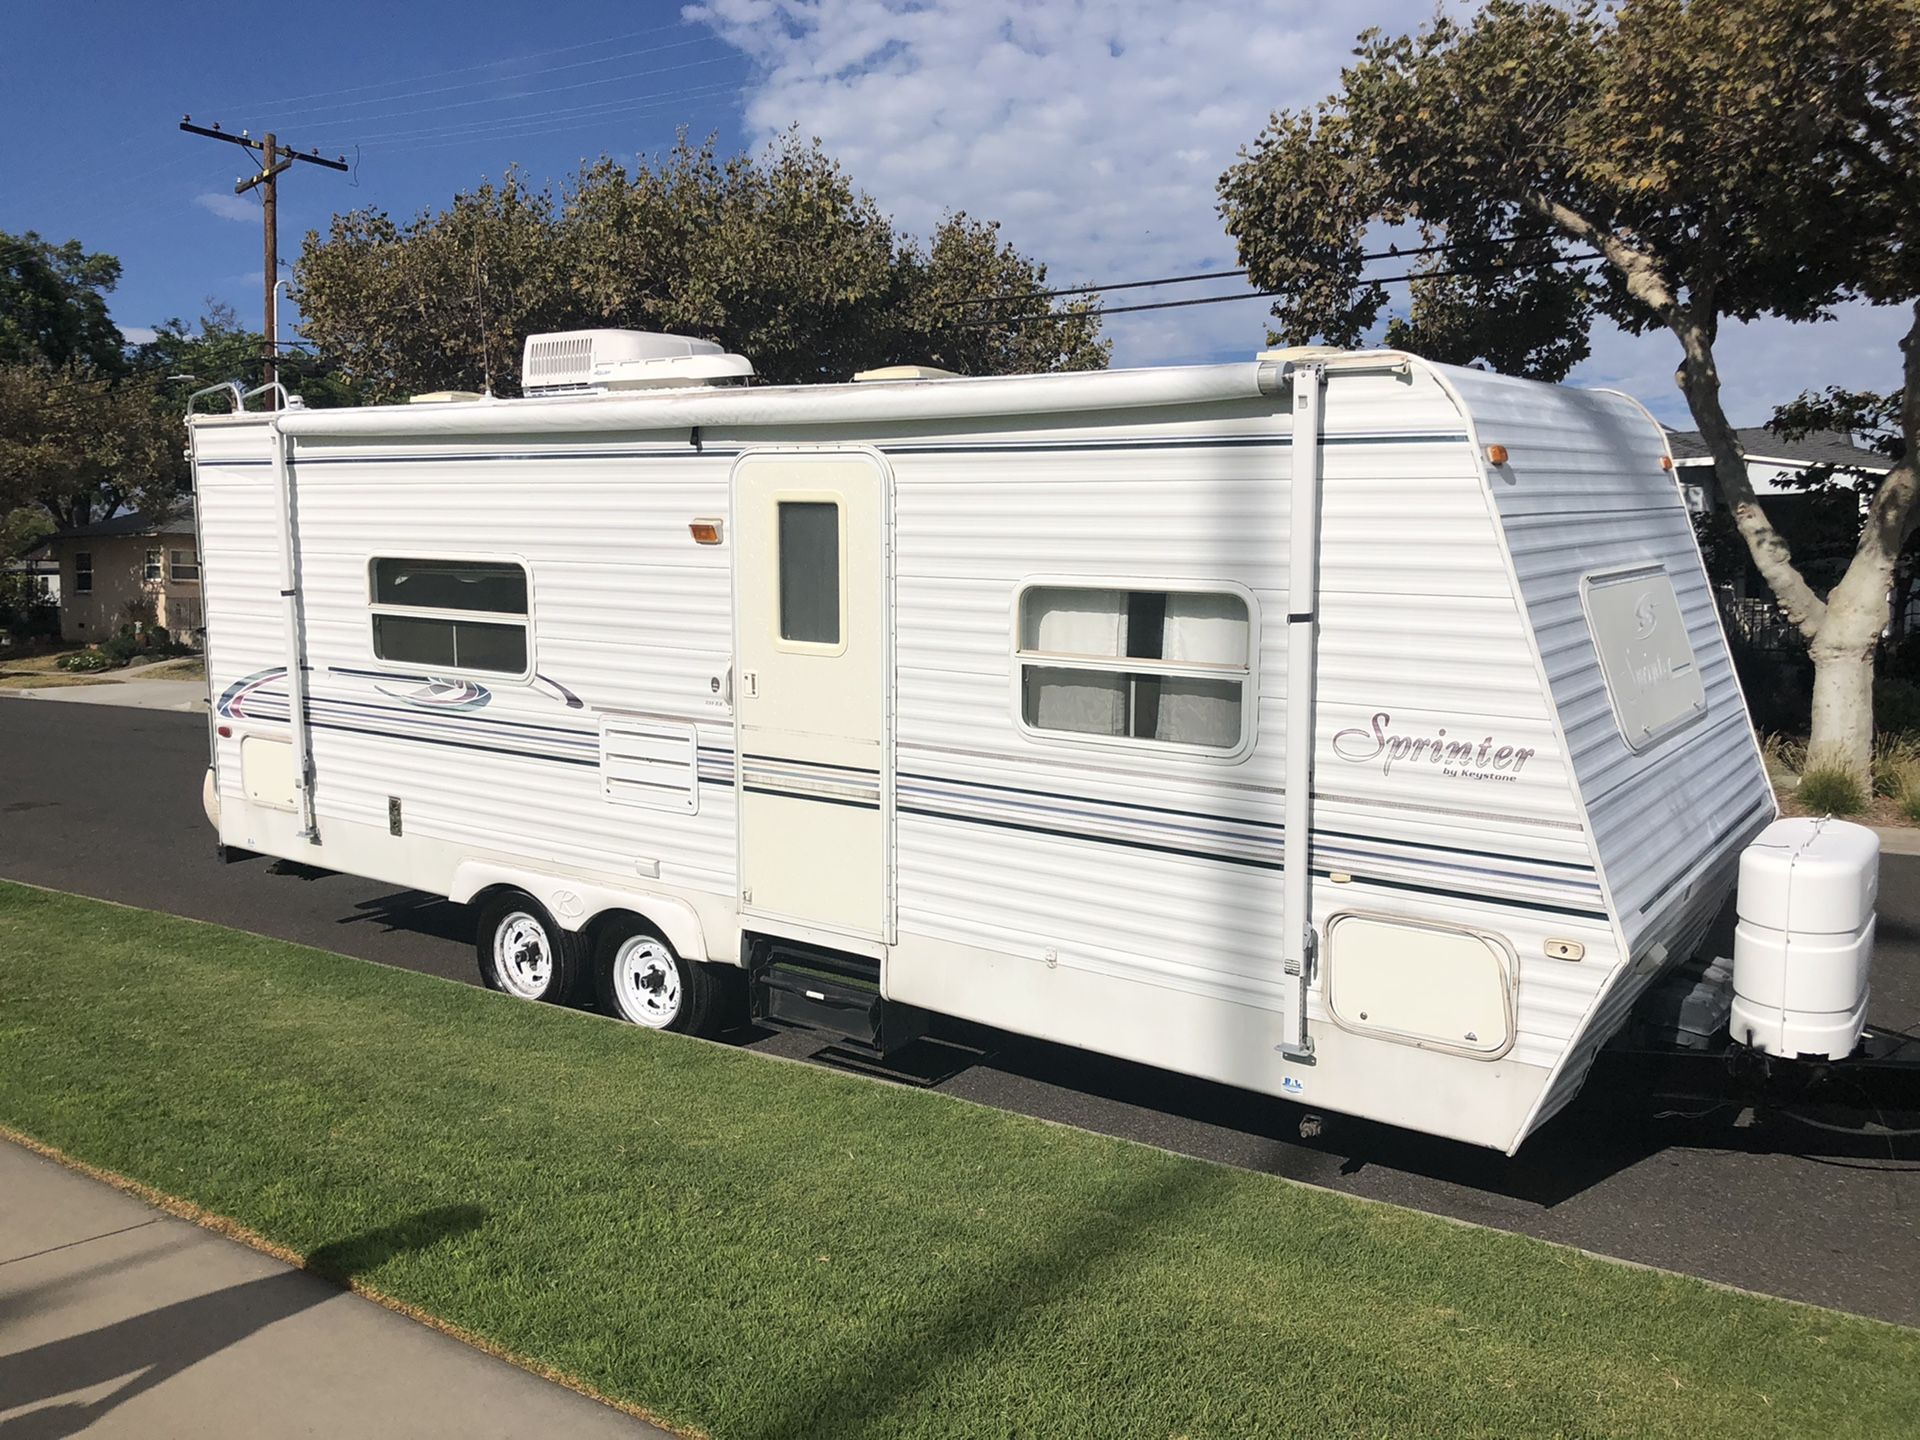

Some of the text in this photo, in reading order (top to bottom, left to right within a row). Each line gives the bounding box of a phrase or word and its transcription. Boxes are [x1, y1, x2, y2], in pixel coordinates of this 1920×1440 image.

[1333, 712, 1535, 777] Sprinter
[1442, 767, 1517, 783] by Keystone
